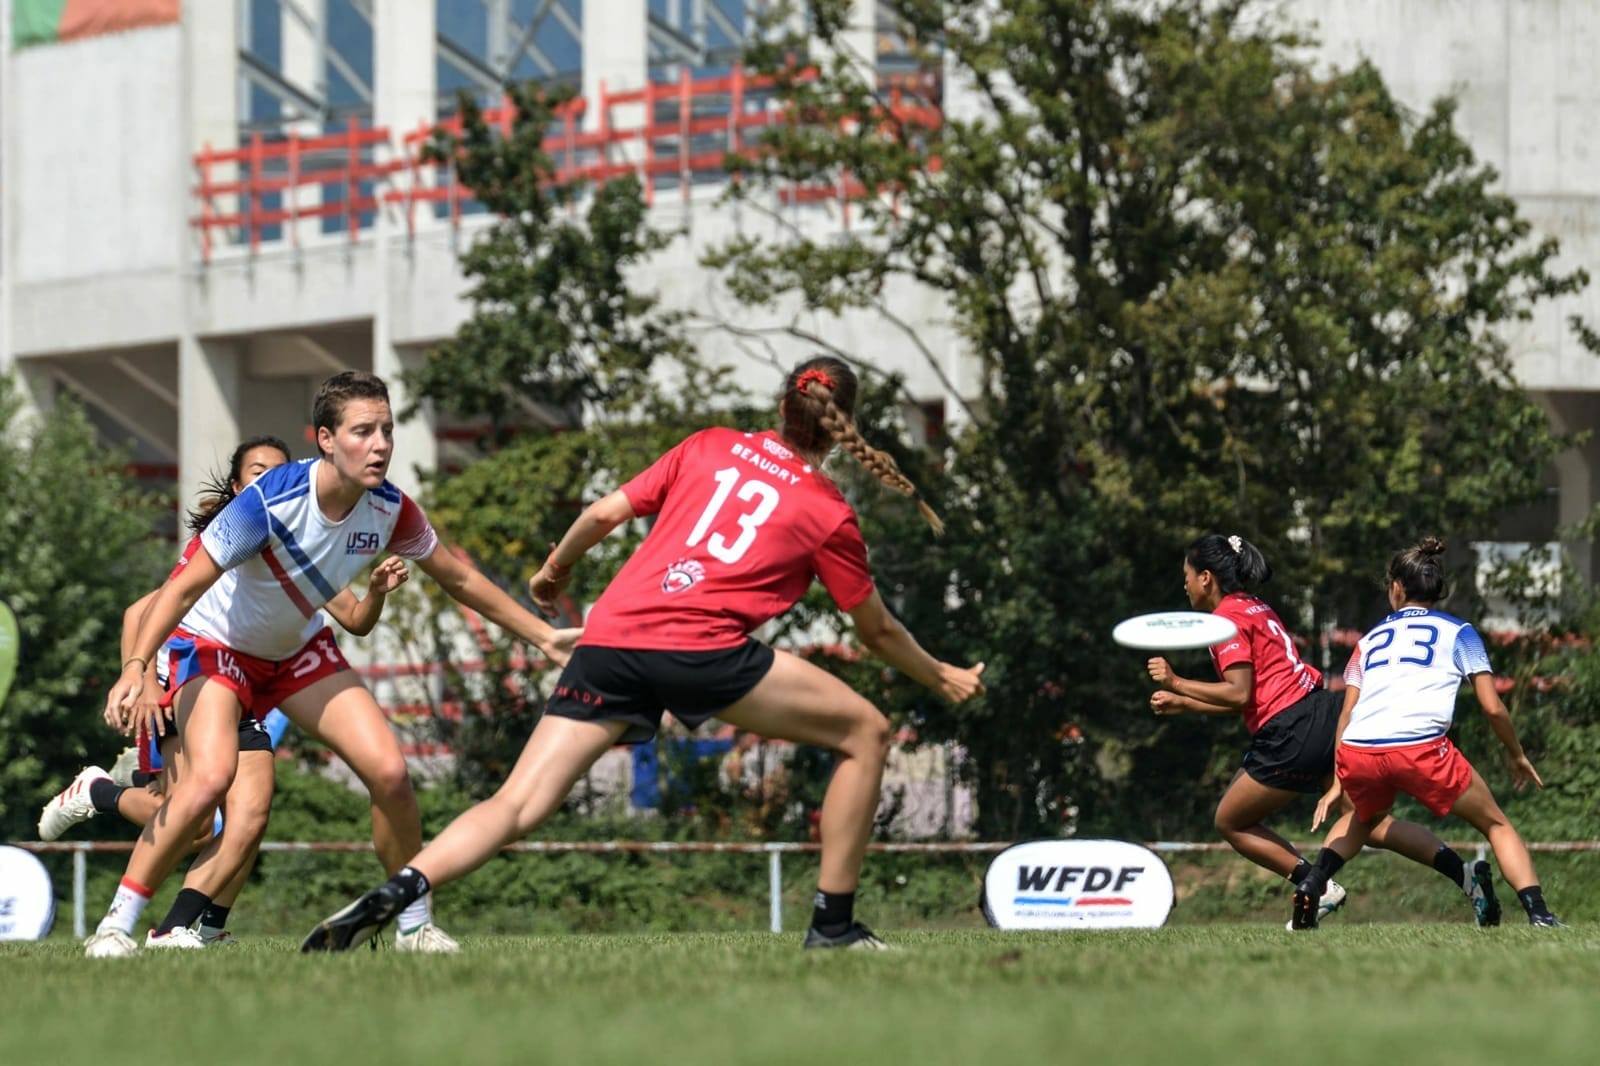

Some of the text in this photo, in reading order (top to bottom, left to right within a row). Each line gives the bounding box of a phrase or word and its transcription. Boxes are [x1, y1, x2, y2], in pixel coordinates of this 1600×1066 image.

[731, 443, 801, 485] BEAUDRY
[685, 467, 780, 564] 13
[346, 532, 380, 549] USA
[1364, 624, 1439, 671] 23
[1018, 866, 1145, 892] WFDF
